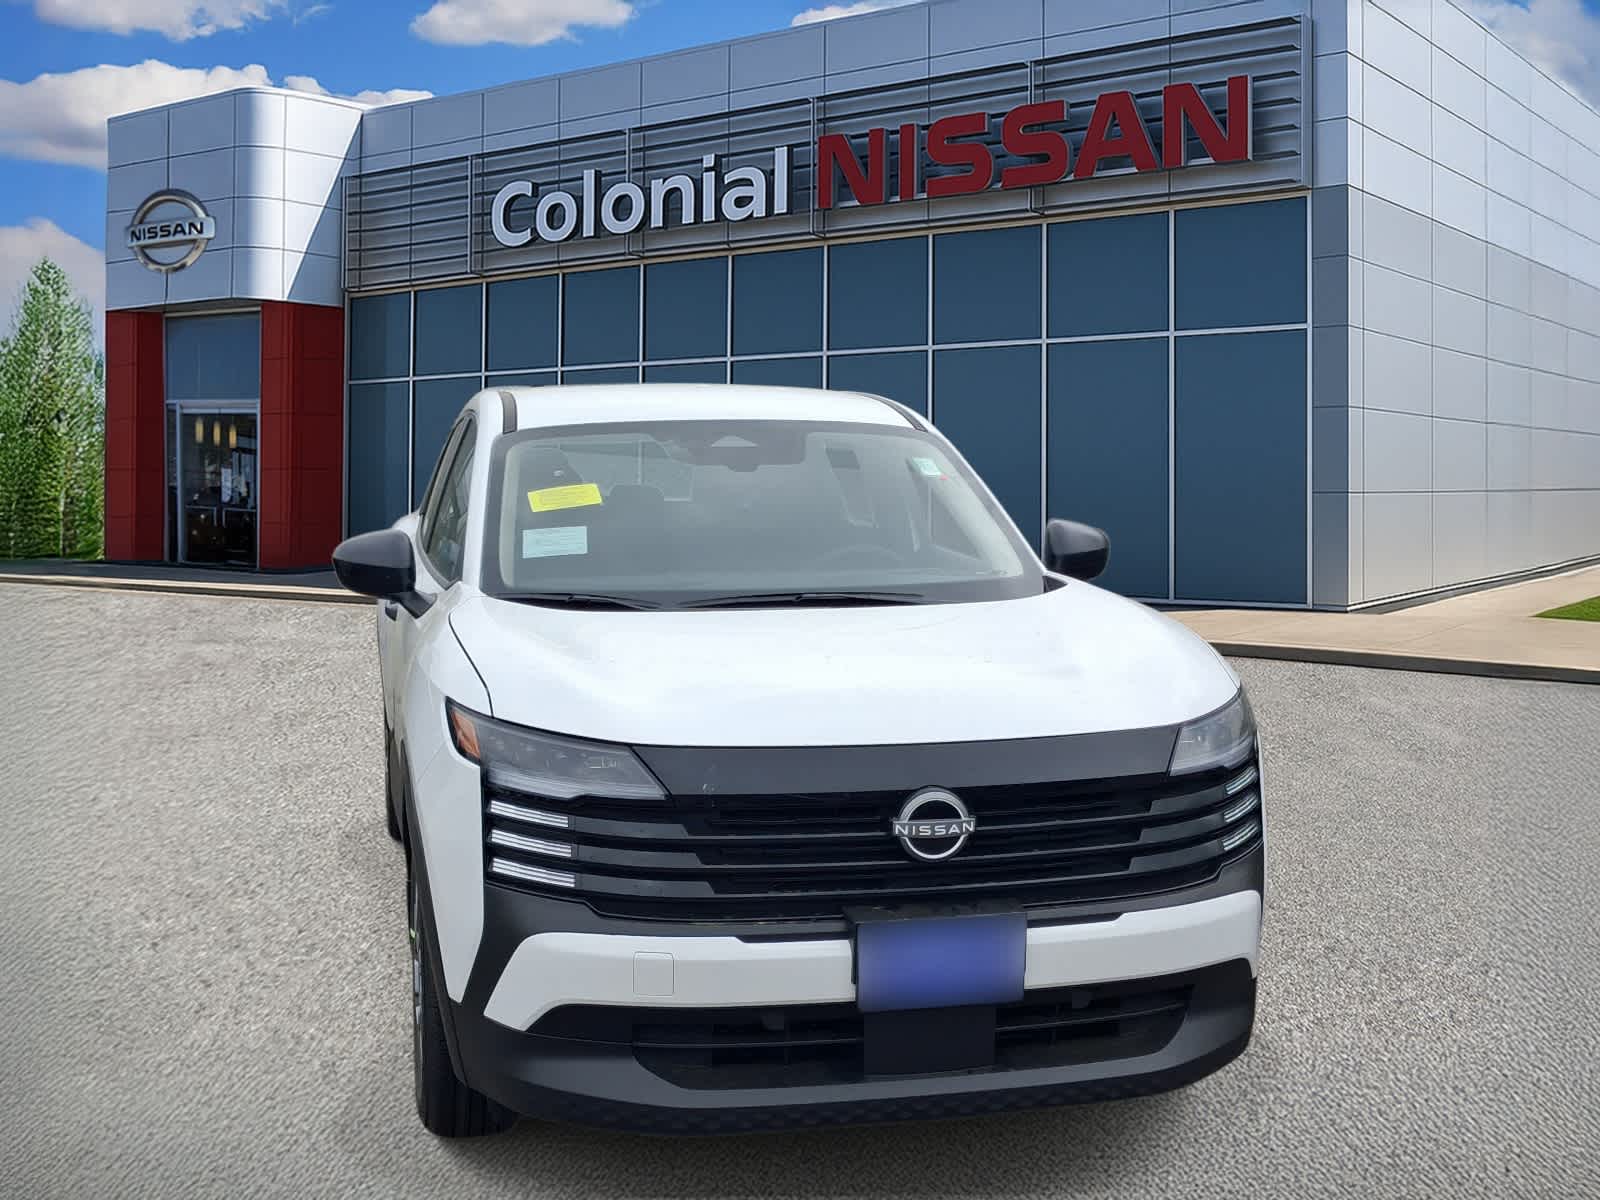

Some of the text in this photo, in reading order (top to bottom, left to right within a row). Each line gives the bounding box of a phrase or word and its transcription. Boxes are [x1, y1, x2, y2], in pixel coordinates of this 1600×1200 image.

[491, 75, 1253, 248] Colonial NISSAN
[130, 221, 204, 242] NISSAN
[895, 821, 974, 836] NISSAN
